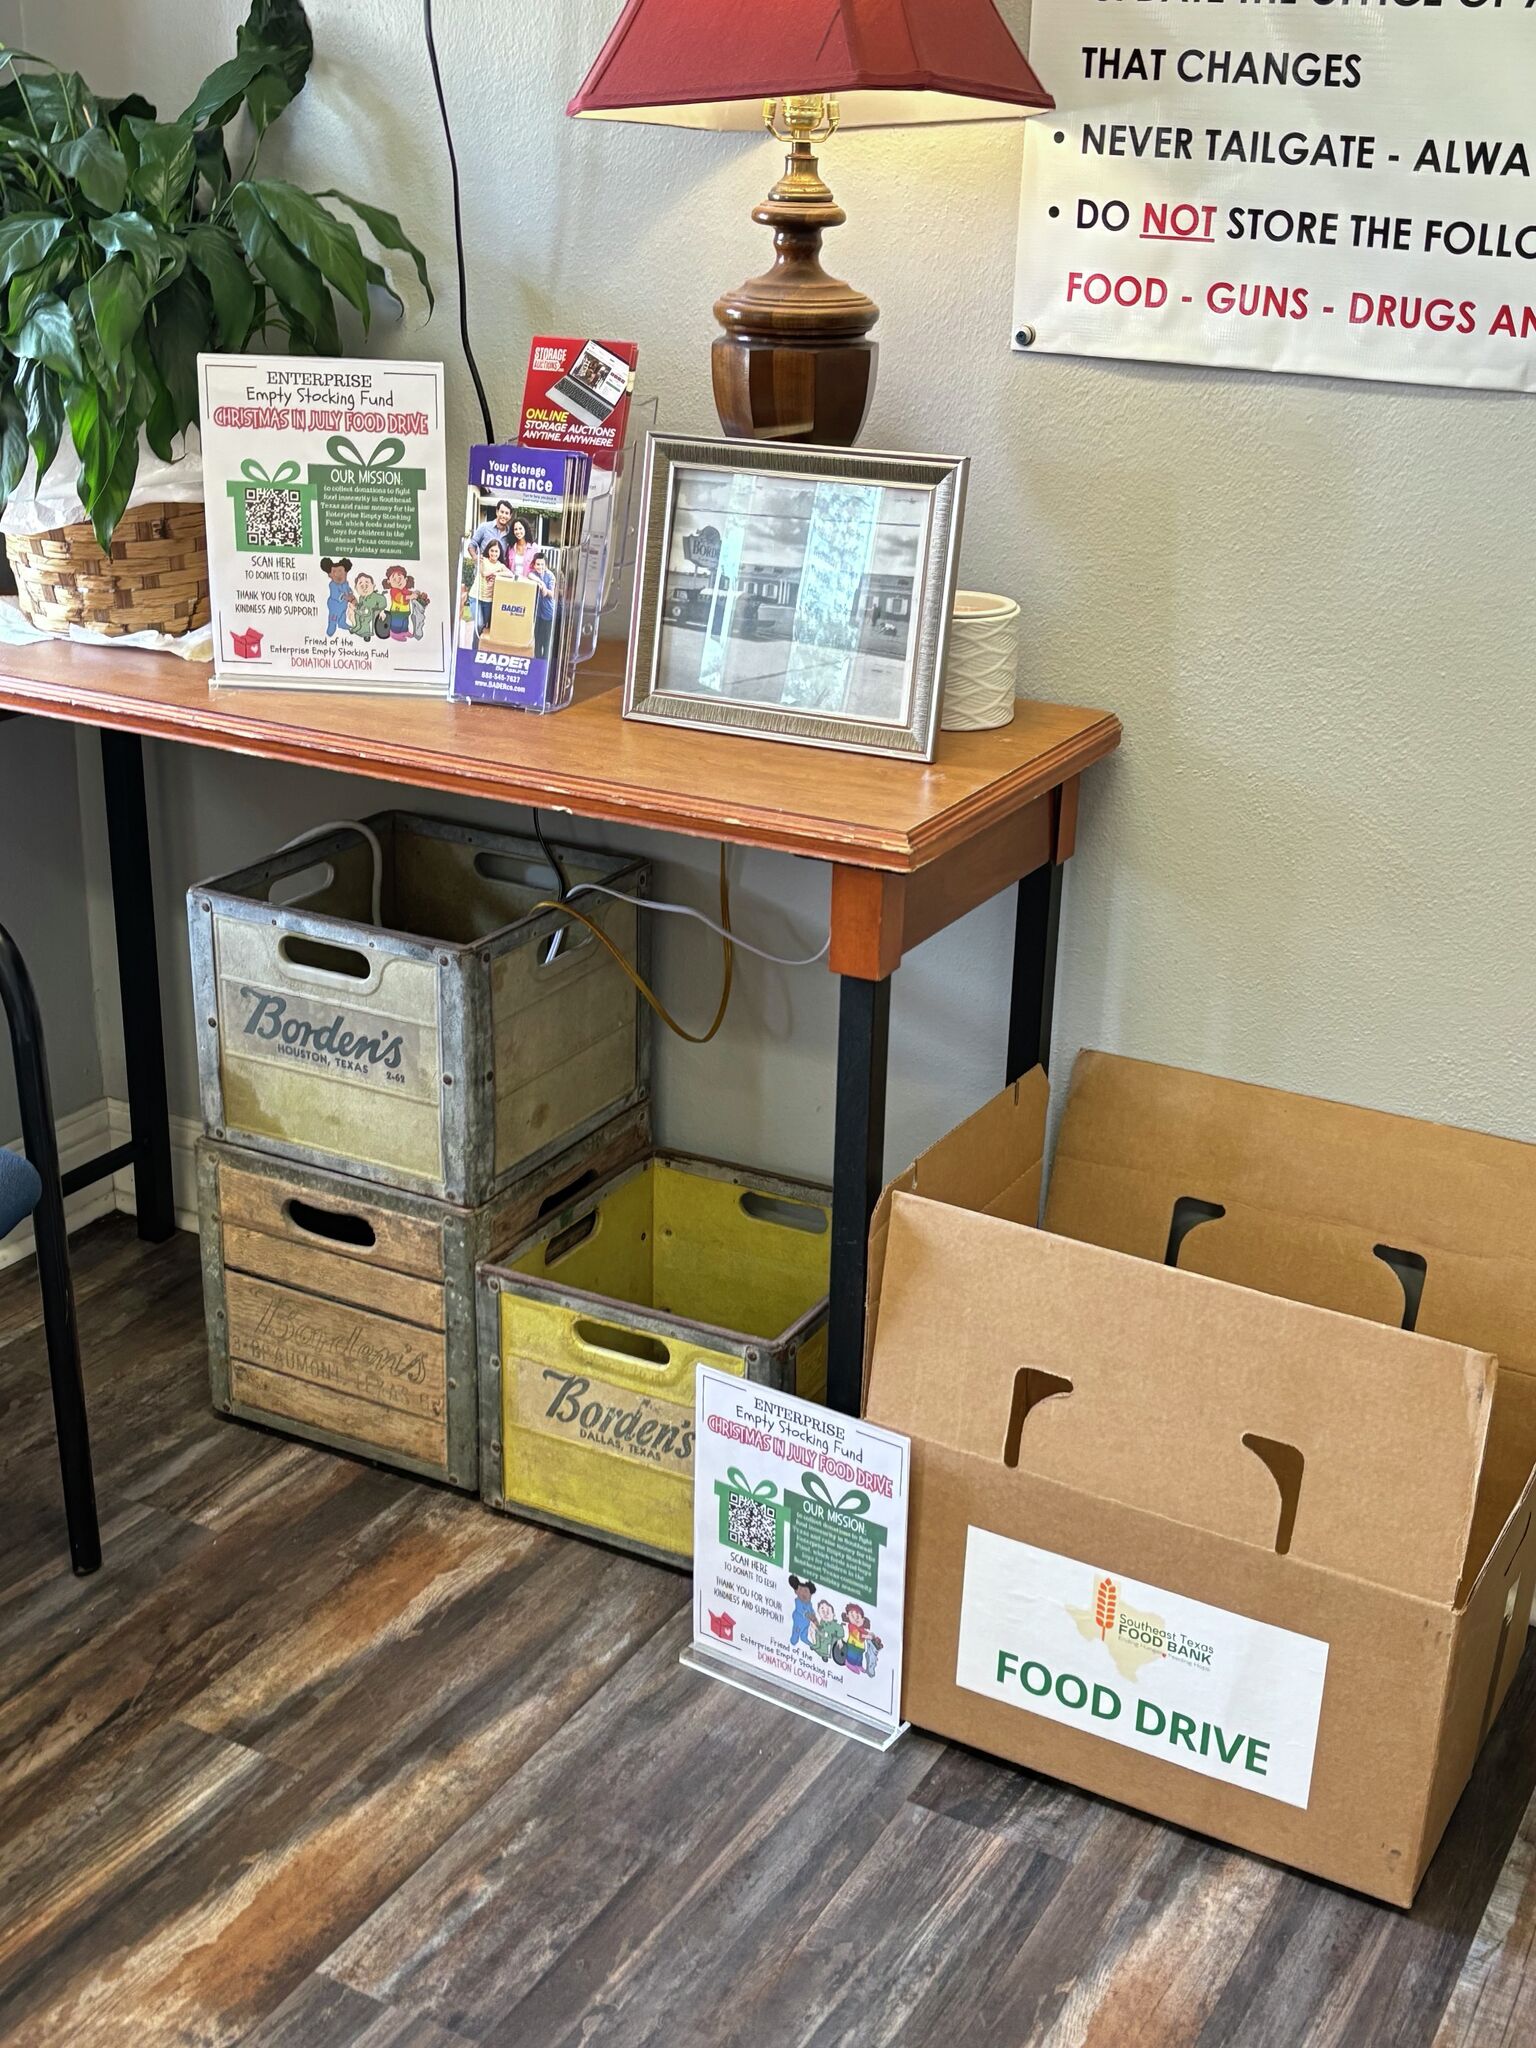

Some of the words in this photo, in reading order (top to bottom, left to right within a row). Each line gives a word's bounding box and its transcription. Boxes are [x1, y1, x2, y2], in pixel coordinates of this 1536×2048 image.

[1082, 47, 1167, 80] THAT
[1177, 49, 1362, 88] CHANGES
[1081, 124, 1193, 159] NEVER
[1205, 129, 1376, 169] TAILGATE
[1077, 198, 1130, 231] DO
[1140, 202, 1217, 238] NOT
[1226, 206, 1339, 245] STORE
[1350, 214, 1412, 251] THE
[1066, 272, 1168, 308] FOOD
[1206, 281, 1309, 321] GUNS
[1348, 292, 1477, 334] DRUGS
[534, 347, 567, 363] STORAGE
[267, 371, 372, 388] ENTERPRISE
[246, 386, 292, 407] Empty
[297, 387, 355, 410] Stocking
[360, 390, 394, 407] Fund
[214, 406, 290, 430] CHRISTMAS
[291, 408, 306, 431] IN
[308, 410, 341, 431] JULY
[345, 411, 385, 433] FOOD
[387, 412, 429, 435] DRIVE
[526, 408, 569, 422] ONLINE
[523, 430, 561, 442] ANYTIME.
[563, 434, 614, 447] ANYWHERE.
[524, 420, 568, 432] STORAGE
[568, 424, 616, 438] AUCTIONS
[330, 469, 355, 484] OUR
[359, 470, 403, 486] MISSION:
[481, 469, 553, 493] Insurance
[489, 460, 509, 472] Your
[511, 462, 546, 478] Storage
[251, 555, 273, 568] SCAN
[276, 557, 296, 569] HERE
[245, 570, 254, 580] TO
[255, 570, 280, 580] DONATE
[282, 572, 290, 581] TO
[236, 590, 259, 600] THANK
[260, 591, 277, 601] YOU
[278, 592, 293, 602] FOR
[294, 593, 316, 603] YOUR
[235, 603, 266, 614] KINDNESS
[268, 605, 282, 615] AND
[283, 606, 318, 616] SUPPORT!
[270, 645, 310, 656] Enterprise
[312, 647, 336, 658] Empty
[338, 647, 369, 660] Stocking
[371, 649, 389, 658] Fund
[304, 636, 327, 646] Friend
[330, 637, 339, 645] of
[341, 638, 353, 646] the
[291, 657, 331, 668] DONATION
[333, 659, 372, 671] LOCATION
[474, 651, 530, 670] BADER
[240, 986, 403, 1069] Borden's
[277, 1044, 331, 1066] HOUSTON,
[334, 1057, 369, 1074] TEXAS
[542, 1370, 696, 1458] Borden's
[754, 1397, 845, 1440] ENTERPRISE
[580, 1428, 624, 1451] DALLAS,
[629, 1444, 661, 1461] TEXAS
[736, 1405, 775, 1433] Empty
[779, 1420, 829, 1455] Stocking
[834, 1440, 863, 1463] Fund
[707, 1414, 771, 1452] CHRISTMAS
[772, 1437, 786, 1460] IN
[787, 1442, 818, 1469] JULY
[818, 1453, 855, 1482] FOOD
[856, 1467, 893, 1499] DRIVE
[803, 1500, 824, 1520] OUR
[827, 1509, 867, 1536] MISSION:
[724, 1561, 732, 1571] TO
[733, 1565, 754, 1580] DONATE
[756, 1574, 763, 1584] TO
[730, 1552, 749, 1567] SCAN
[751, 1560, 768, 1575] HERE
[714, 1587, 740, 1606] KINDNESS
[741, 1599, 754, 1611] AND
[716, 1576, 735, 1591] THANK
[736, 1584, 750, 1597] YOU
[751, 1590, 763, 1603] FOR
[765, 1596, 783, 1612] YOUR
[1119, 1624, 1163, 1648] FOOD
[1167, 1641, 1211, 1665] BANK
[1120, 1613, 1176, 1641] Southeast
[1180, 1634, 1214, 1654] Texas
[740, 1633, 774, 1653] Enterprise
[776, 1649, 797, 1664] Empty
[799, 1659, 826, 1678] Stocking
[827, 1670, 844, 1684] Fund
[770, 1637, 790, 1652] Friend
[802, 1651, 813, 1661] the
[757, 1651, 792, 1673] DONATION
[794, 1667, 828, 1688] LOCATION
[997, 1649, 1122, 1721] FOOD
[1135, 1698, 1271, 1776] DRIVE
